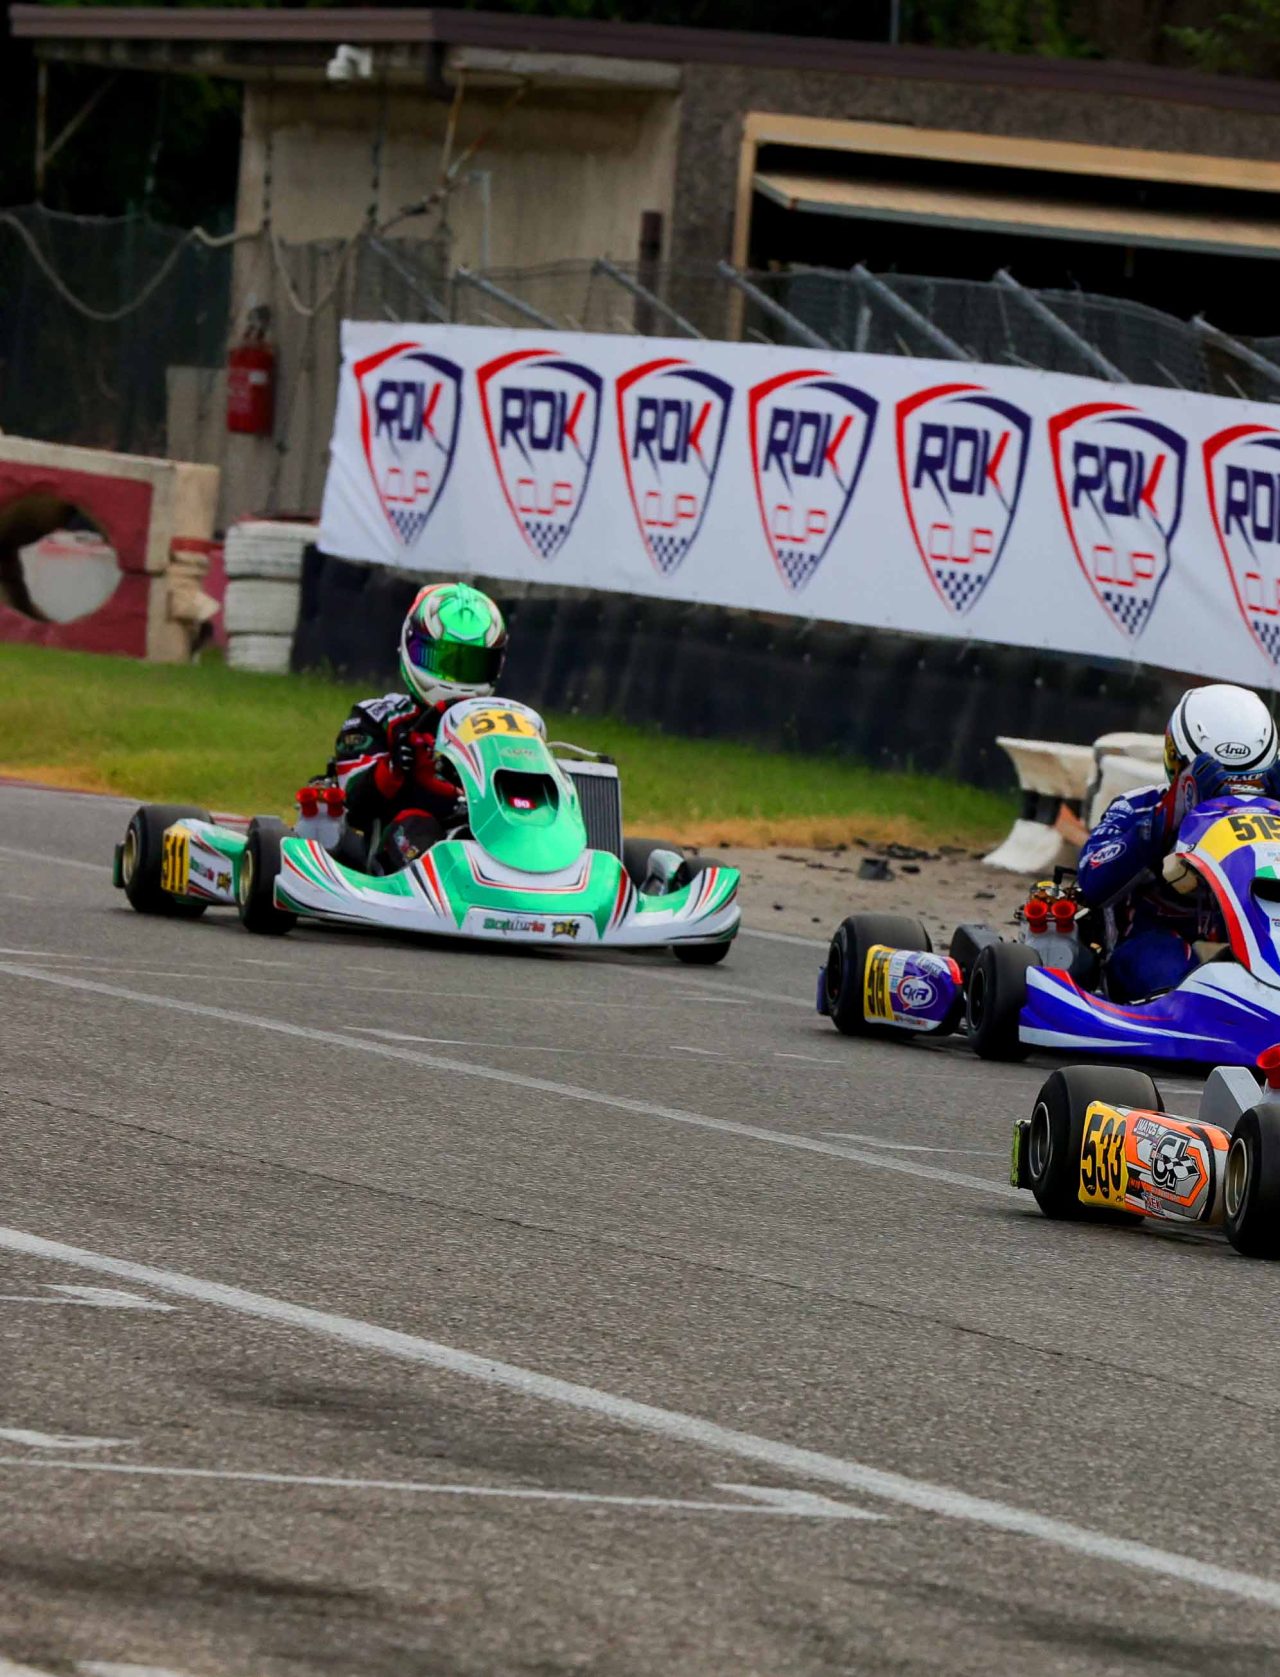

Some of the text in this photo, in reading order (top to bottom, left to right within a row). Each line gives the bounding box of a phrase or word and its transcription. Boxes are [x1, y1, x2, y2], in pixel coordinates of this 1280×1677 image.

[375, 381, 442, 456] ROK
[501, 388, 585, 469] ROK
[634, 397, 712, 482] ROK
[763, 409, 852, 494] ROK
[384, 469, 430, 503] CUP
[914, 423, 1010, 516] ROK
[1073, 441, 1166, 537] ROK
[517, 479, 572, 514] CUP
[645, 492, 697, 526] CUP
[774, 505, 827, 542] CUP
[929, 523, 993, 563] CUP
[1094, 546, 1154, 586] CUP
[1218, 743, 1247, 755] Arai
[902, 984, 929, 1001] CKR
[1082, 1113, 1127, 1199] 533
